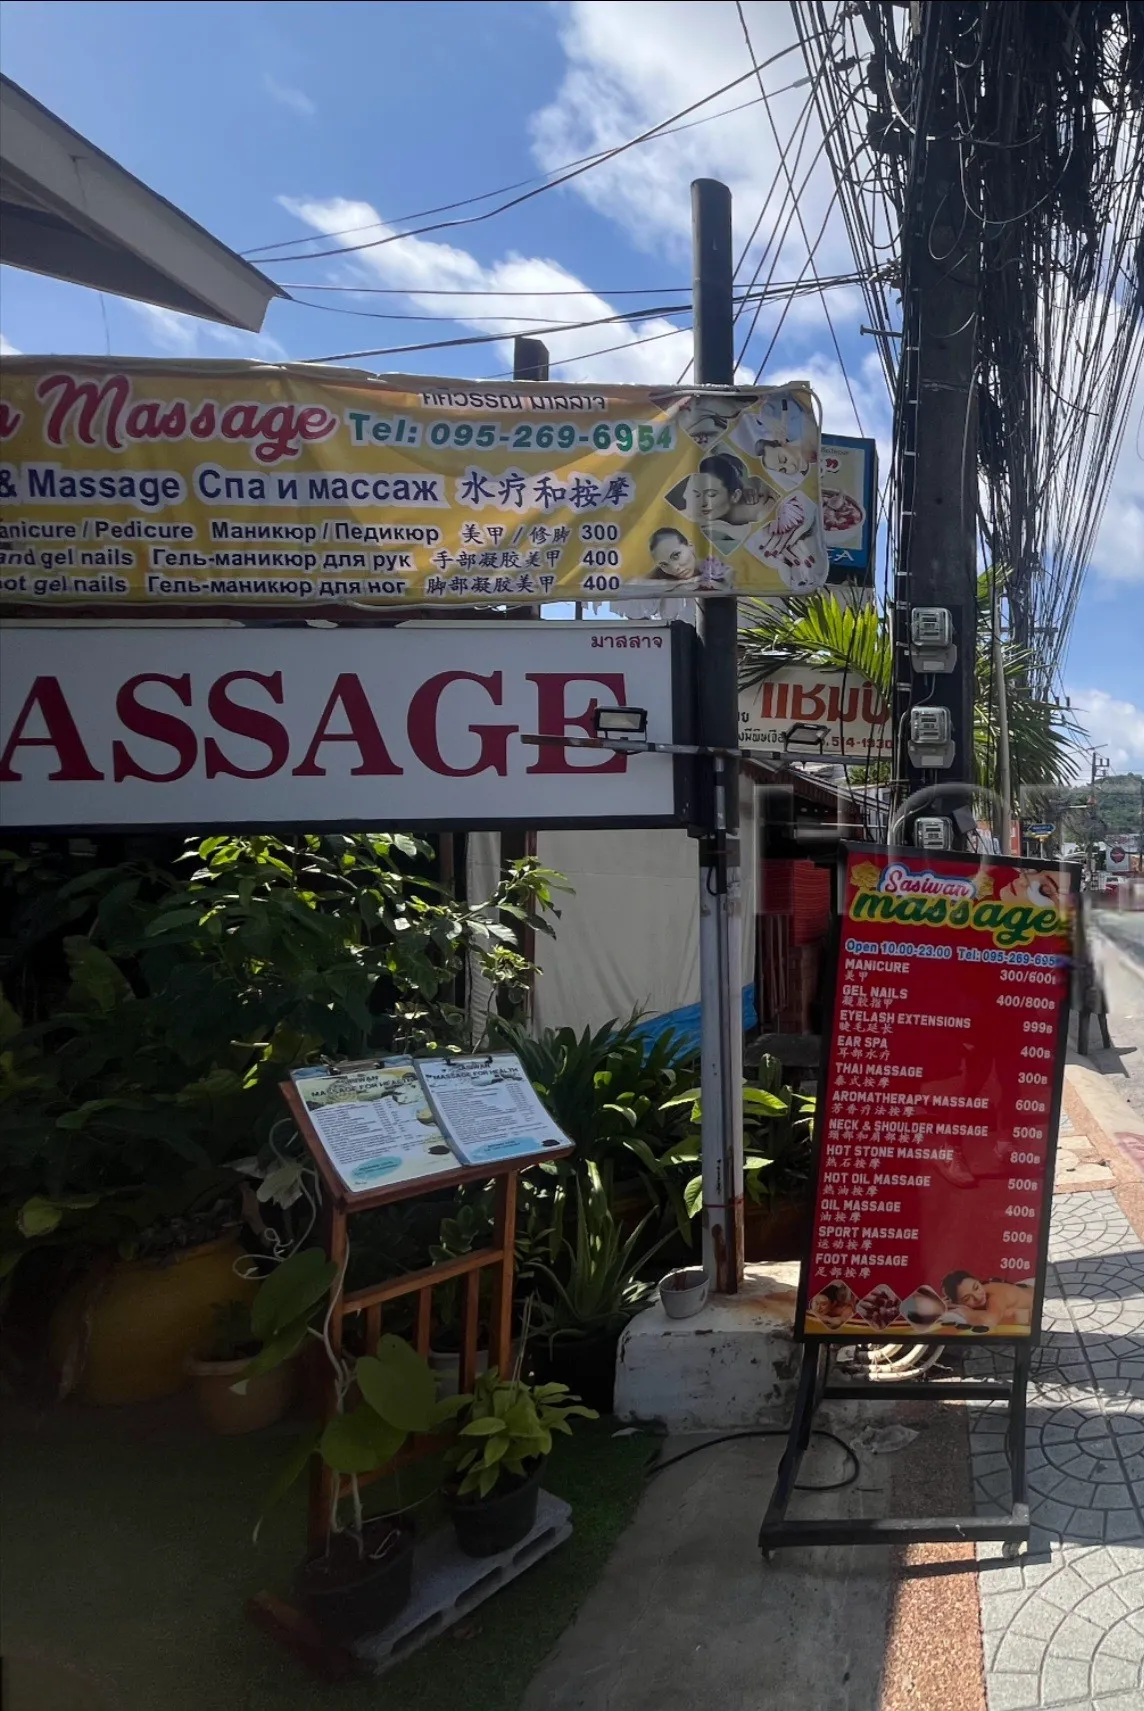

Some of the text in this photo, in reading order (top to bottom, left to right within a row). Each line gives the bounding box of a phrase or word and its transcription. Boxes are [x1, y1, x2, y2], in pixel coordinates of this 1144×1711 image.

[38, 374, 335, 463] Massage
[349, 412, 672, 452] Tel: 095-269-6954
[28, 468, 181, 506] Massage
[198, 469, 438, 502] Спа и массаж
[461, 471, 630, 508] 水疗和按摩
[0, 520, 76, 539] anicure
[95, 520, 194, 539] Pedicure
[212, 521, 316, 543] Маникюр
[335, 522, 439, 546] Педикюр
[462, 523, 504, 545] 美甲
[581, 524, 619, 541] 300
[0, 548, 133, 569] and gel nails
[153, 548, 411, 571] Гель-маникюр для рук
[433, 549, 561, 570] 手部凝胶美甲
[582, 550, 619, 566] 400
[0, 575, 126, 595] ot gel nails
[148, 576, 405, 597] Гель-маникюр для ног
[426, 575, 555, 595] 脚部凝胶美甲
[583, 575, 620, 591] 400
[591, 635, 663, 649] มาสสาจ
[0, 669, 628, 783] ASSAGE
[884, 869, 970, 898] Sasiwan
[853, 892, 1063, 945] massage
[845, 938, 1066, 968] Open 10.00-23.00 Tel: 095-269-695
[845, 959, 910, 974] MANICURE
[842, 985, 908, 1000] GEL NAILS
[840, 1009, 972, 1029] EYELASH EXTENSIONS
[836, 1035, 888, 1049] EAR SPA
[835, 1062, 924, 1078] THAI MASSAGE
[832, 1090, 989, 1109] AROMATHERAPY MASSAGE
[829, 1118, 989, 1137] NECK & SHOULDER MASSAGE
[826, 1144, 954, 1161] HOT STONE MASSAGE
[823, 1172, 931, 1187] HOT OIL MASSAGE
[821, 1199, 902, 1213] OIL MASSAGE
[818, 1226, 919, 1240] SPORT MASSAGE
[815, 1253, 909, 1267] FOOT MASSAGE
